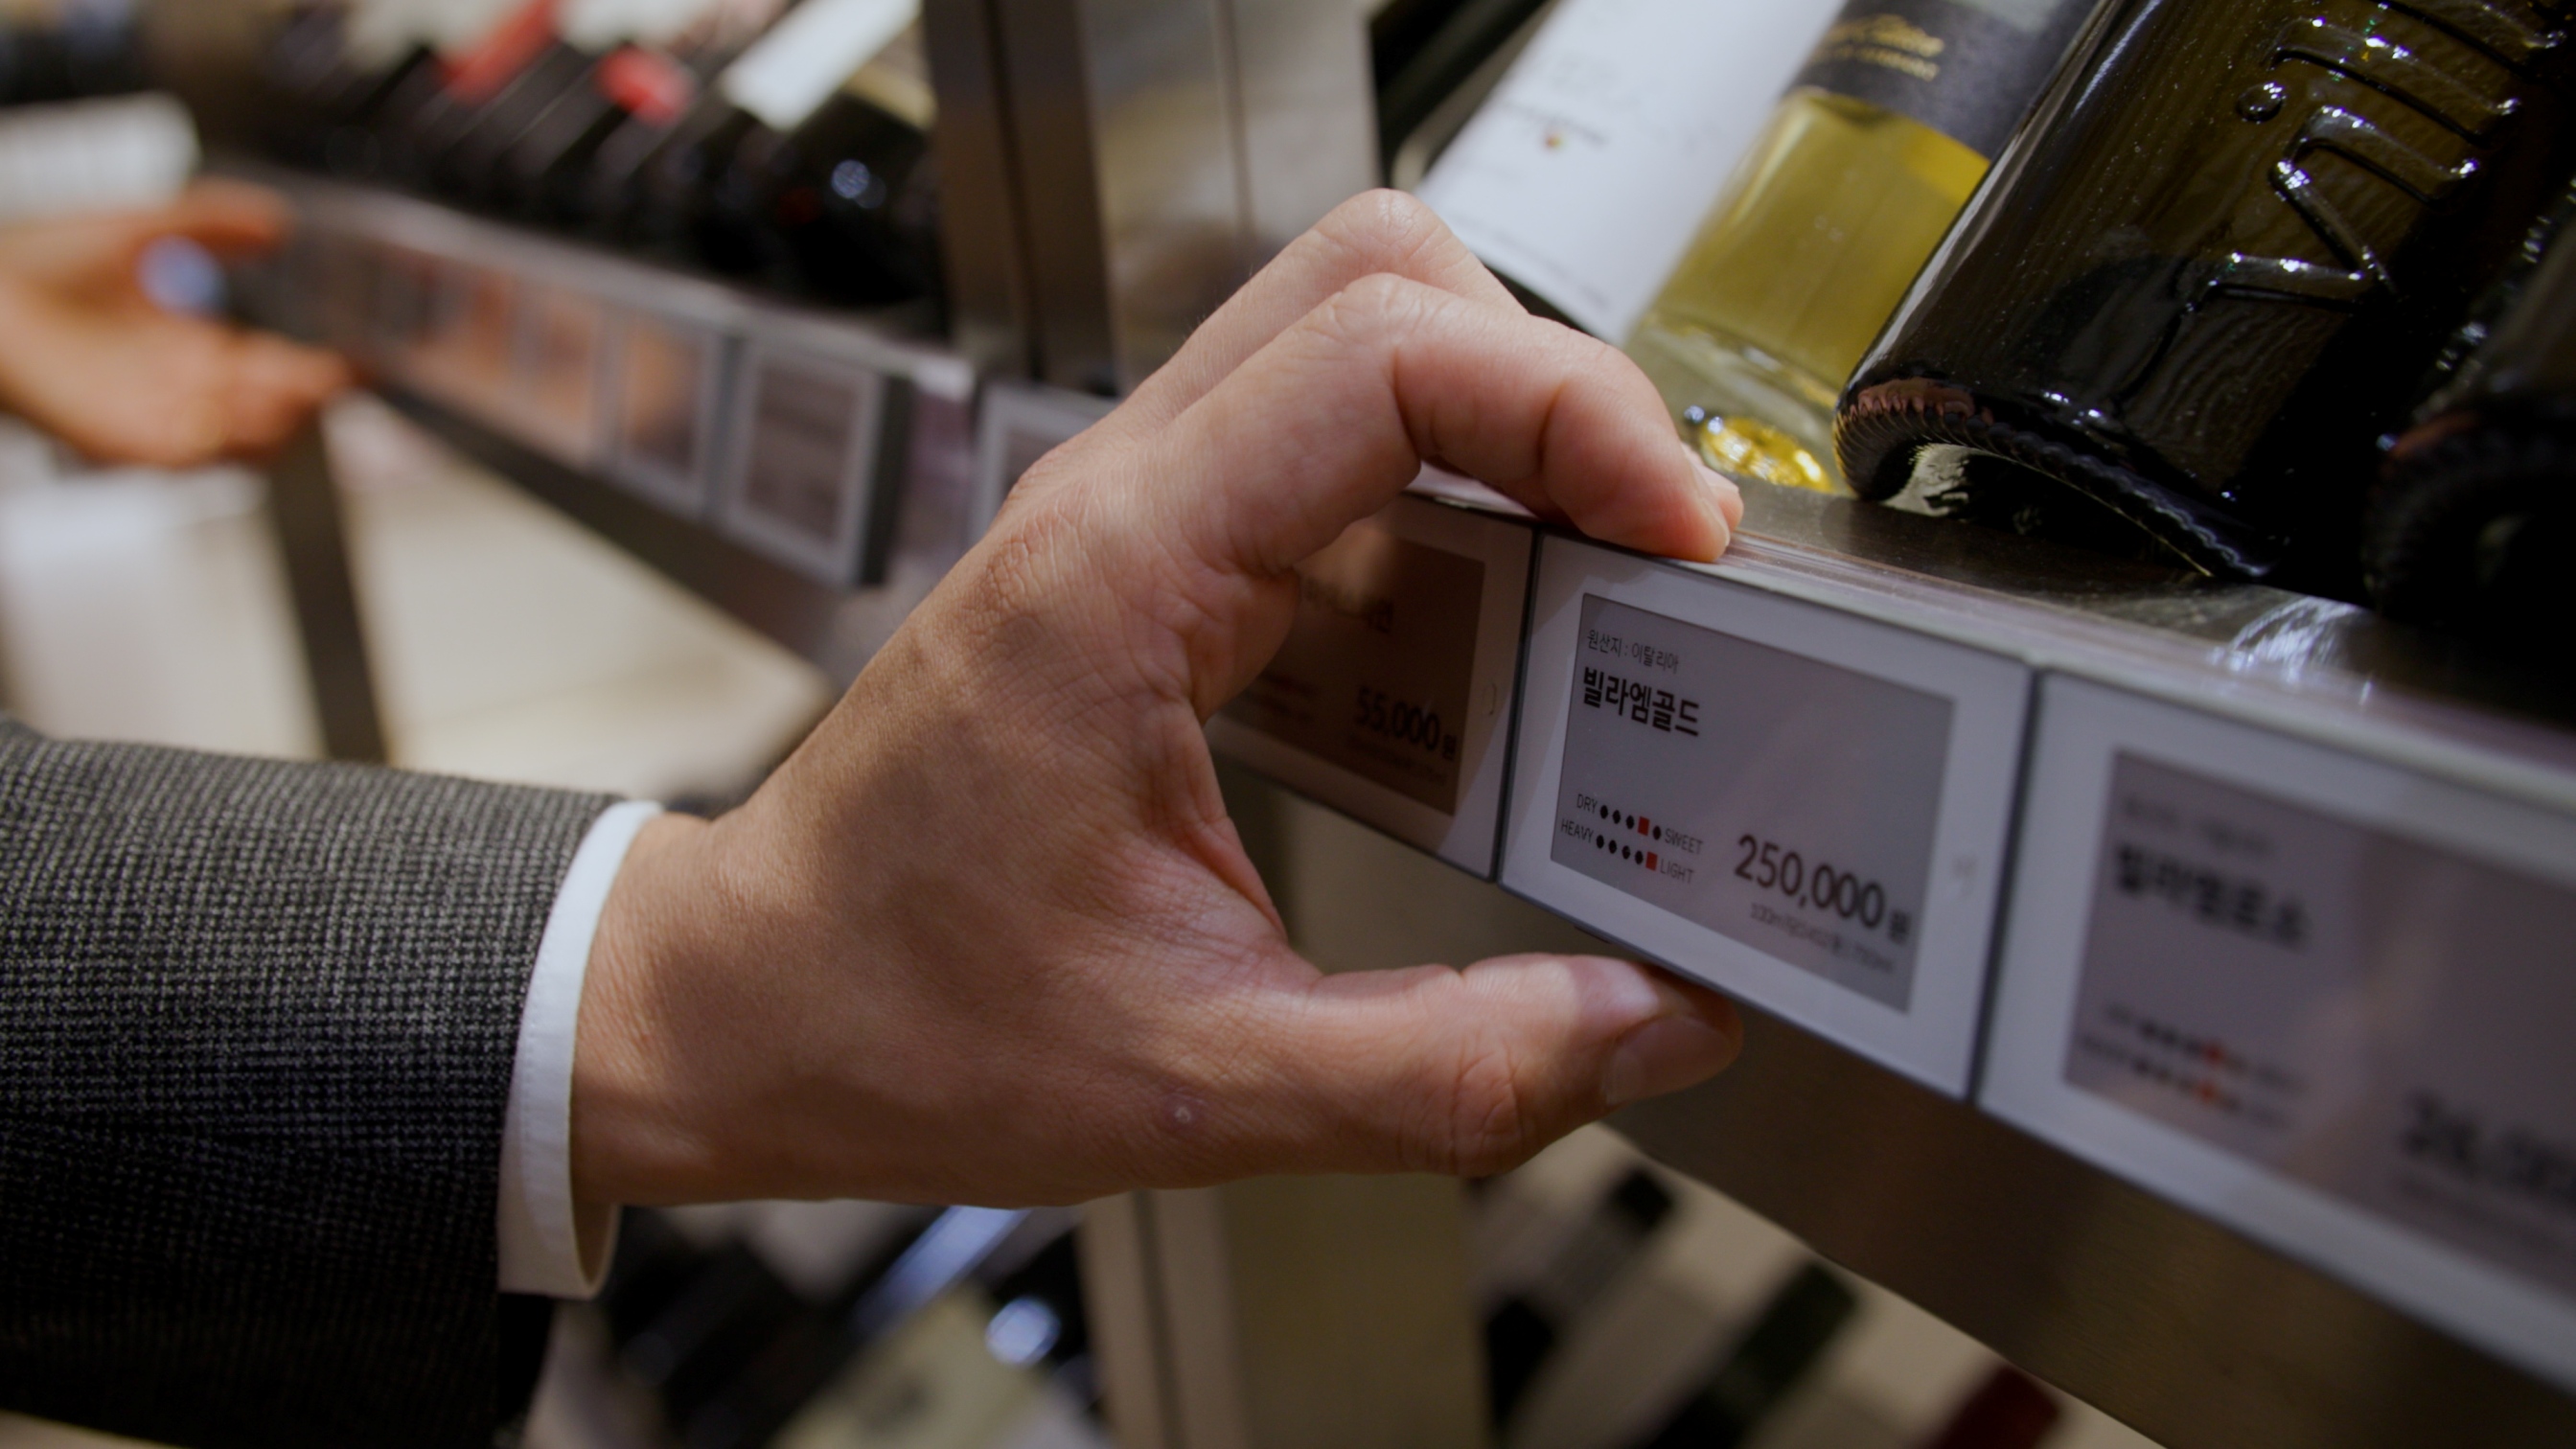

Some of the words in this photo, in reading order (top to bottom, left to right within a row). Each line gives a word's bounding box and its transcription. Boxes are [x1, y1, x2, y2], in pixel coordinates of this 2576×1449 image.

[1587, 629, 1622, 657] 원산지
[1631, 642, 1680, 674] 이탈리아
[1583, 666, 1700, 737] 빌라엠골드
[1560, 818, 1594, 844] HEAVY
[1659, 858, 1695, 885] LIGHT
[1576, 793, 1598, 815] DRY
[1664, 827, 1704, 855] SWEET
